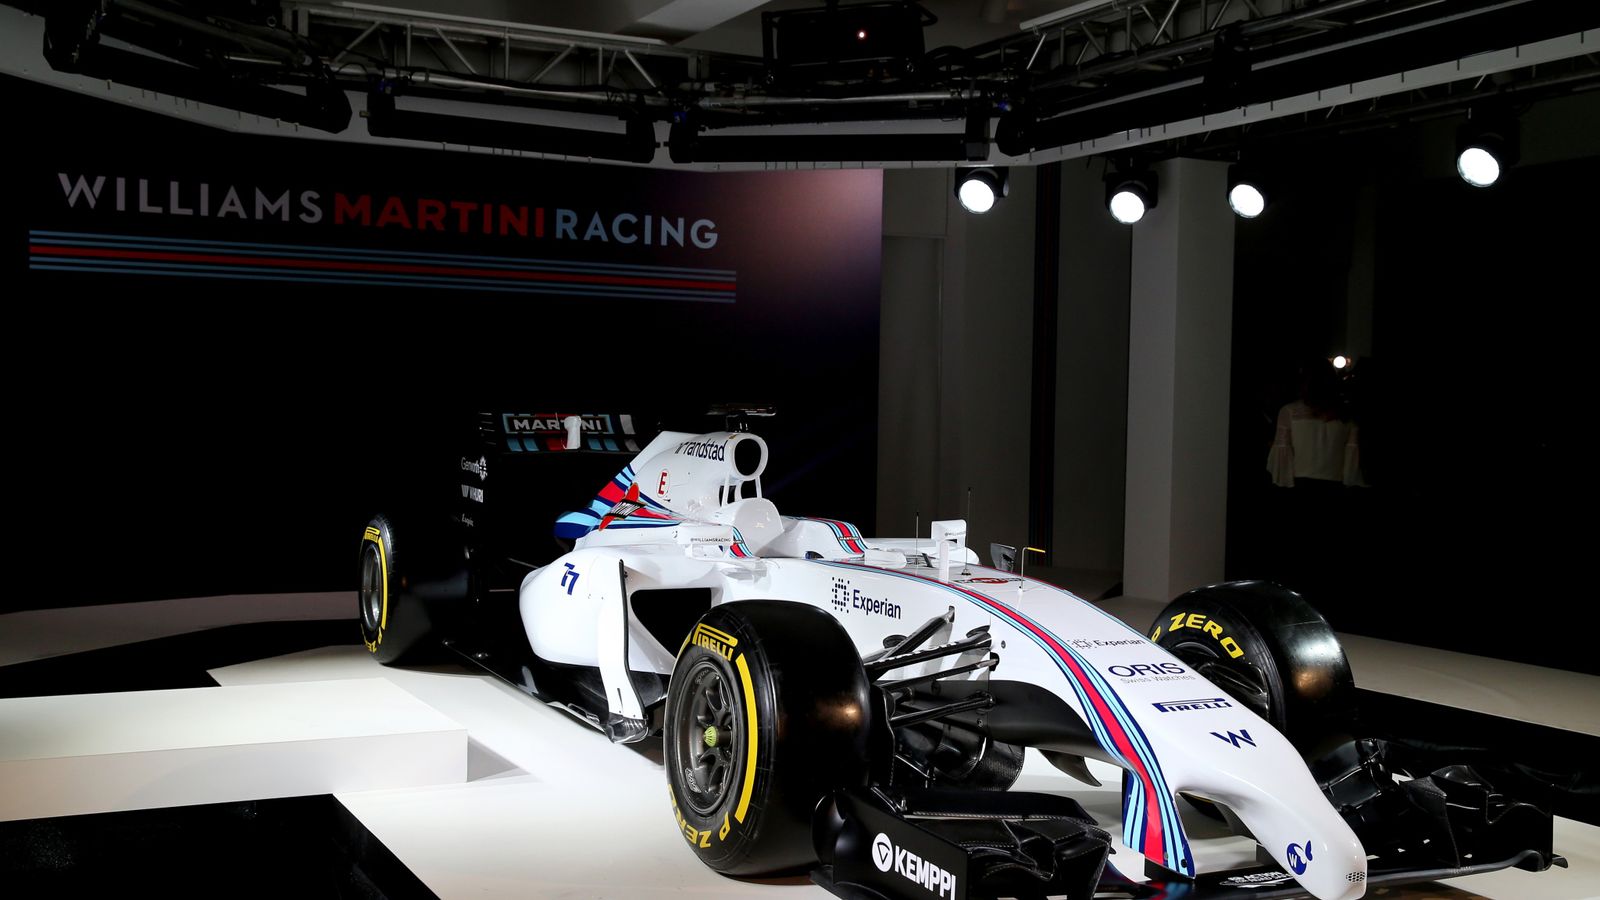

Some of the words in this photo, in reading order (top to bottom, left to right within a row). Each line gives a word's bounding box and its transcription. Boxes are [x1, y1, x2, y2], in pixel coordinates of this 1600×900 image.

[57, 171, 324, 225] WILLIAMS
[333, 191, 546, 239] MARTINI
[554, 207, 719, 250] RACING
[683, 437, 729, 463] randstad
[657, 471, 668, 495] E
[560, 561, 580, 596] 77
[852, 588, 902, 621] Experian
[691, 622, 739, 662] PIRELLI
[1093, 638, 1147, 648] Experian
[1168, 612, 1245, 659] ZERO
[1107, 662, 1186, 678] ORIS
[1151, 697, 1233, 713] PIRELLI
[894, 844, 957, 900] KEMPPI
